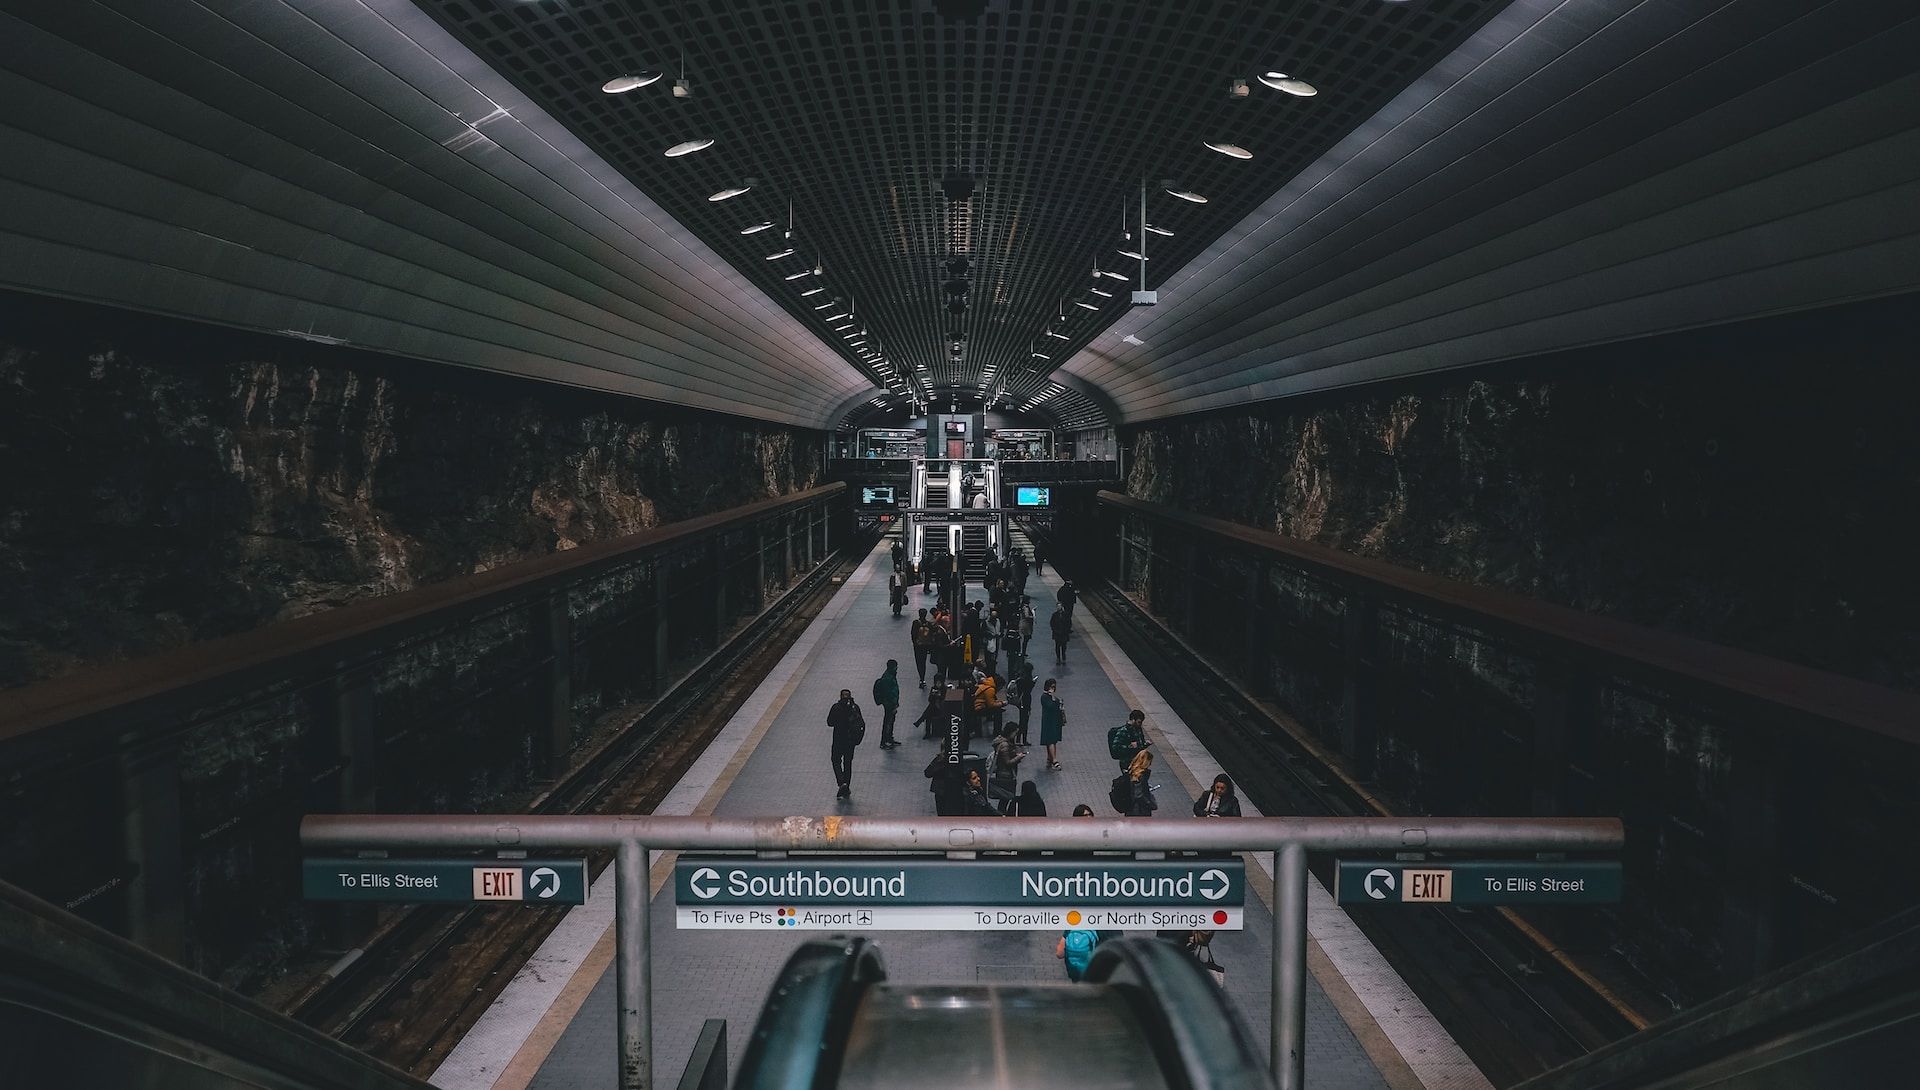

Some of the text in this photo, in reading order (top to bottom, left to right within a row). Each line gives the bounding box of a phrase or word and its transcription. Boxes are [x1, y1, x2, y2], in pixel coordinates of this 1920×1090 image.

[948, 715, 961, 764] Directory
[338, 873, 439, 888] To Ellis Street
[482, 872, 515, 896] EXIT
[727, 869, 906, 897] Southbound
[1021, 871, 1193, 898] Northbound
[1412, 873, 1445, 898] EXIT
[1484, 877, 1585, 892] To Ellis Street
[691, 910, 709, 924] To
[714, 910, 744, 924] Five
[749, 910, 773, 924] Pts
[974, 911, 1207, 928] To Doraville or North Springs
